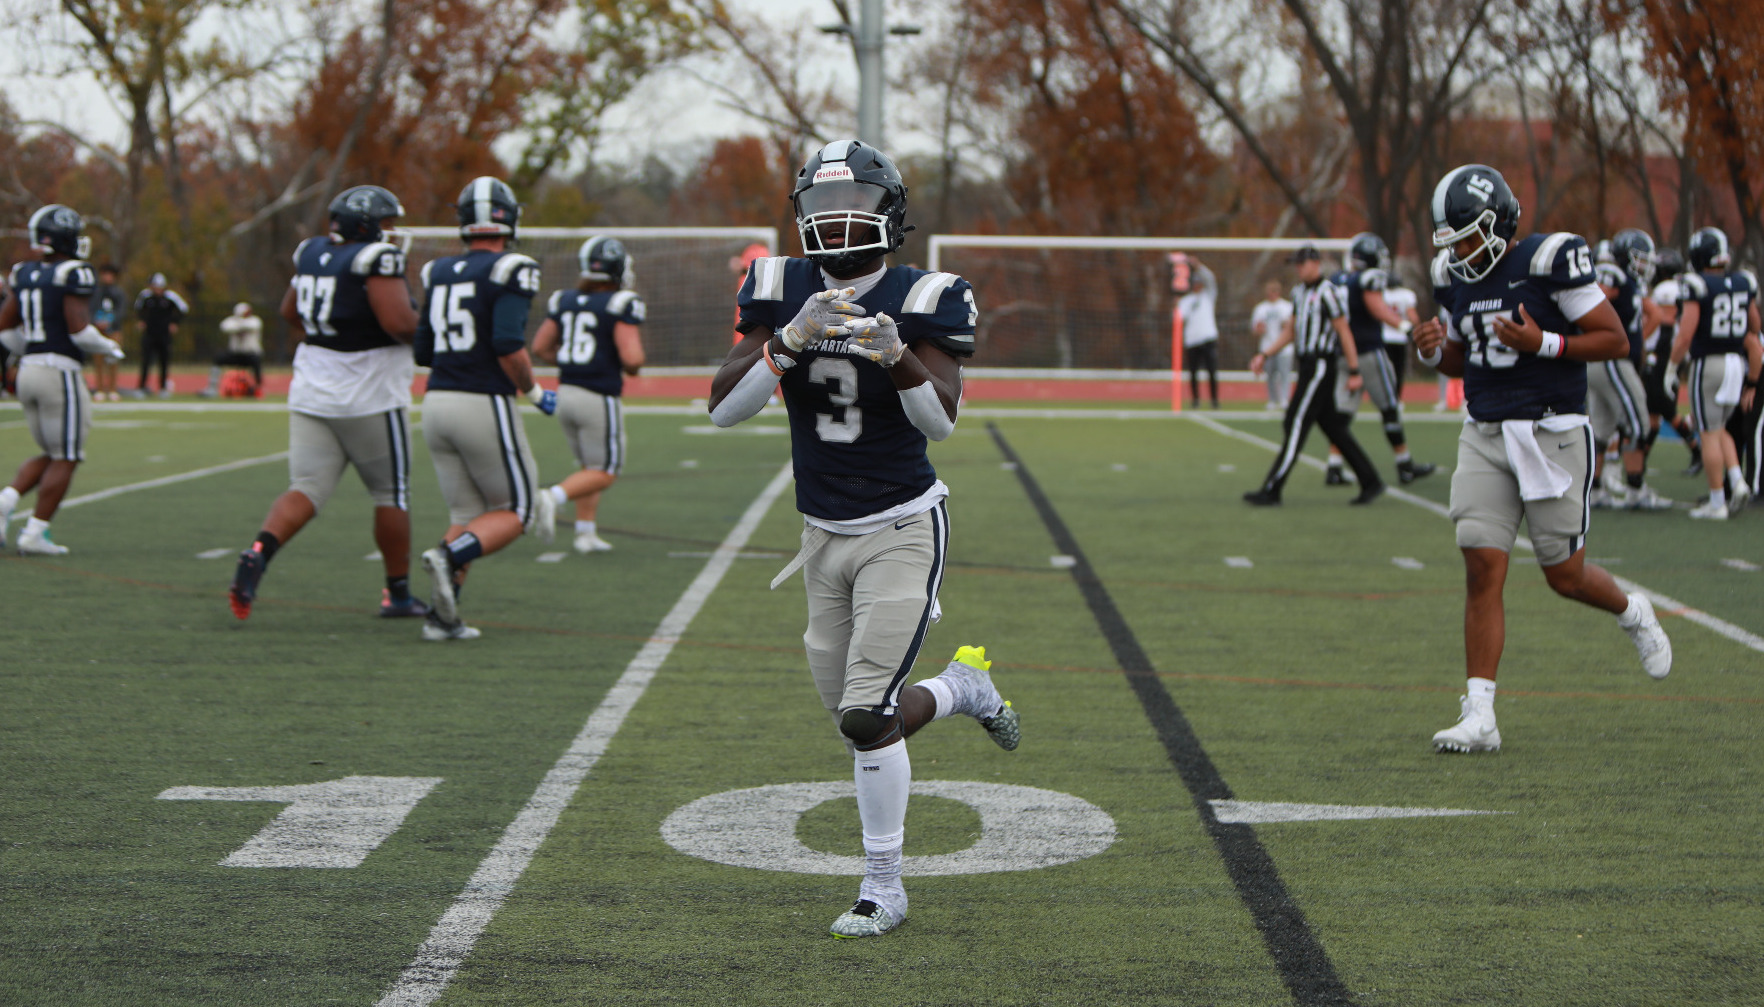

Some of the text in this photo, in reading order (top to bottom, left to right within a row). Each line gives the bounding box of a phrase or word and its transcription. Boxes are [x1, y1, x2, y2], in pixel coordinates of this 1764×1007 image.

[816, 169, 849, 179] Riddell
[1466, 173, 1494, 204] 15
[77, 266, 95, 286] 11
[517, 266, 541, 292] 45
[1566, 244, 1592, 280] 15
[20, 288, 46, 343] 11
[296, 274, 337, 336] 97
[429, 281, 476, 353] 45
[963, 288, 979, 327] 3
[1469, 298, 1502, 313] SPARTANS
[1711, 291, 1749, 339] 25
[556, 310, 598, 364] 16
[808, 356, 862, 444] 3
